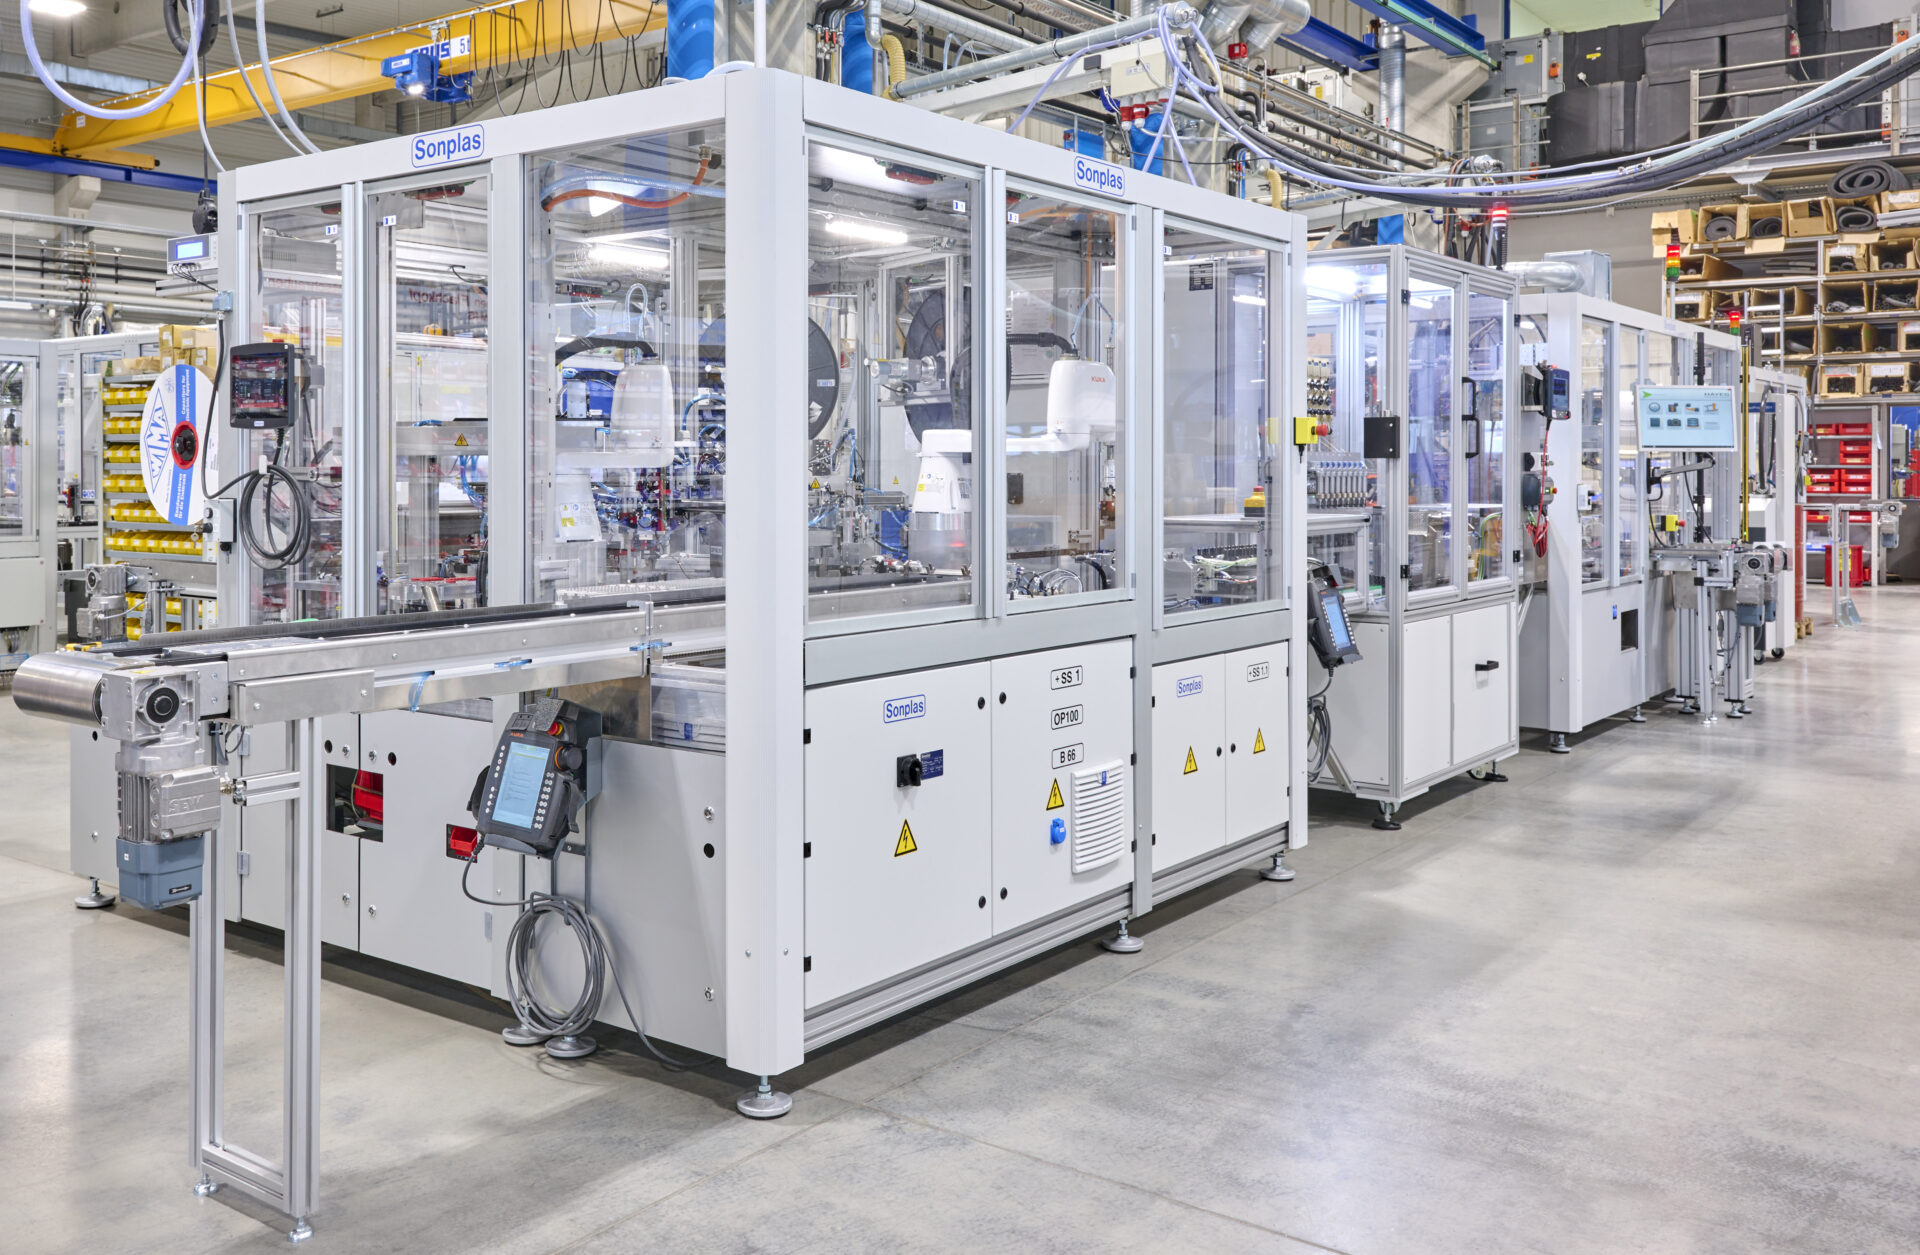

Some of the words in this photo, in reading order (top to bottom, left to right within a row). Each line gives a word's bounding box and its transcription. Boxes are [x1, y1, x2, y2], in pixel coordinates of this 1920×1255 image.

[415, 132, 481, 160] Sonplas
[1077, 160, 1122, 189] Sonplas
[147, 406, 170, 478] WIMA
[1075, 668, 1080, 681] 1
[1178, 680, 1202, 694] Sonplas
[886, 700, 924, 718] Sonplas
[1054, 709, 1079, 725] OP100
[1060, 751, 1066, 764] B
[1067, 749, 1076, 762] 66
